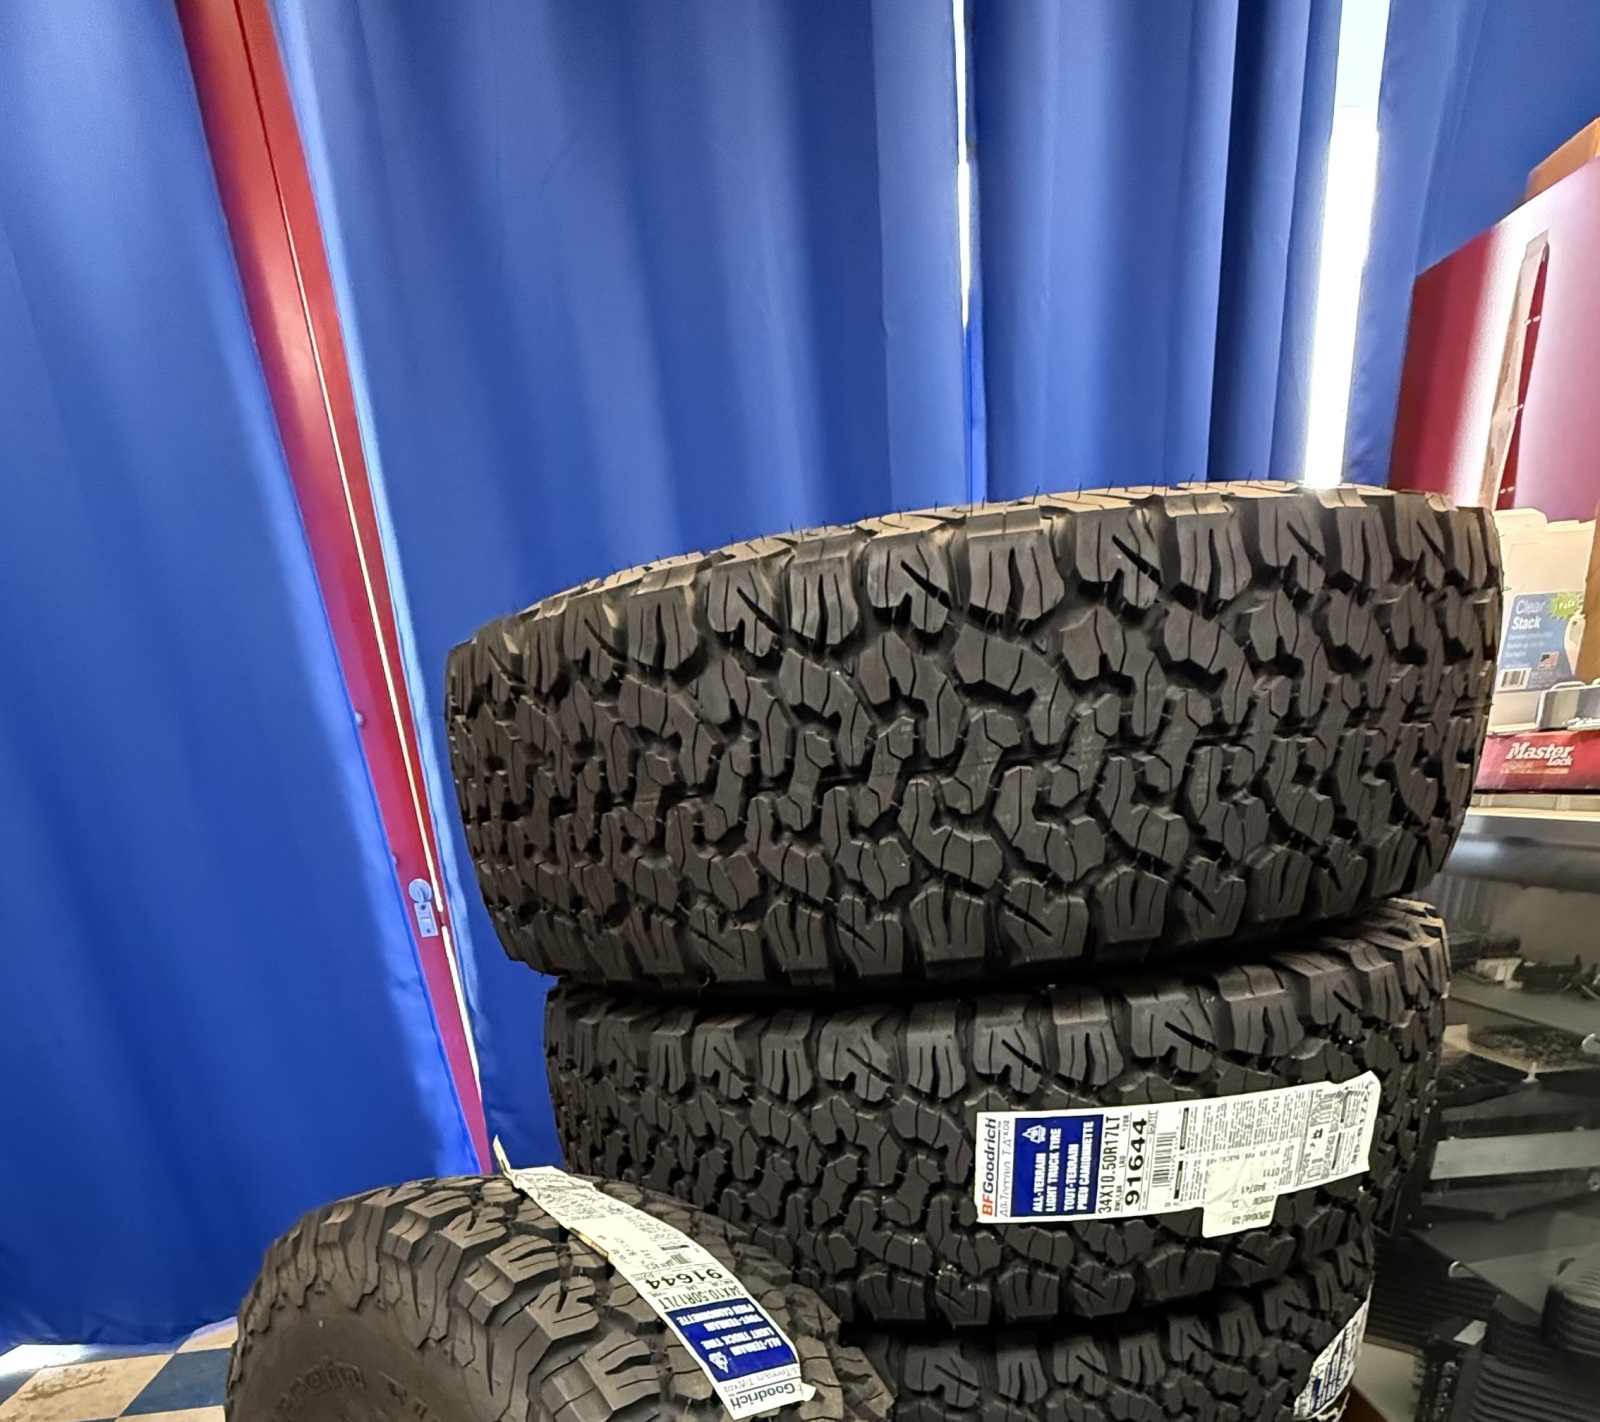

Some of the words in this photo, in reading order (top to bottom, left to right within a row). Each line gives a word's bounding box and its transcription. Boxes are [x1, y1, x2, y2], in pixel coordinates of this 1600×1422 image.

[1515, 599, 1546, 615] Clear
[1511, 615, 1542, 631] Stack
[1505, 741, 1575, 760] Master
[1545, 755, 1573, 767] Lock
[1049, 1127, 1062, 1151] TIRE
[1078, 1120, 1095, 1186] CAMIONNETTE
[1098, 1115, 1121, 1214] 34X10.50R17LT
[1124, 1117, 1148, 1206] 91644
[981, 1117, 997, 1217] BFGoodrich
[1047, 1151, 1060, 1184] TRUCK
[1063, 1143, 1080, 1212] TOUT-TERRAIN
[1000, 1161, 1012, 1217] All-Terrain
[1032, 1152, 1047, 1212] ALL-TERRAIN
[1045, 1185, 1058, 1212] LIGHT
[1076, 1186, 1090, 1211] PNEU
[645, 1268, 723, 1290] 91644
[658, 1285, 745, 1310] 34X10.50R17LT
[729, 1337, 782, 1356] ALL-TERRAIN
[729, 1382, 796, 1410] Goodrich
